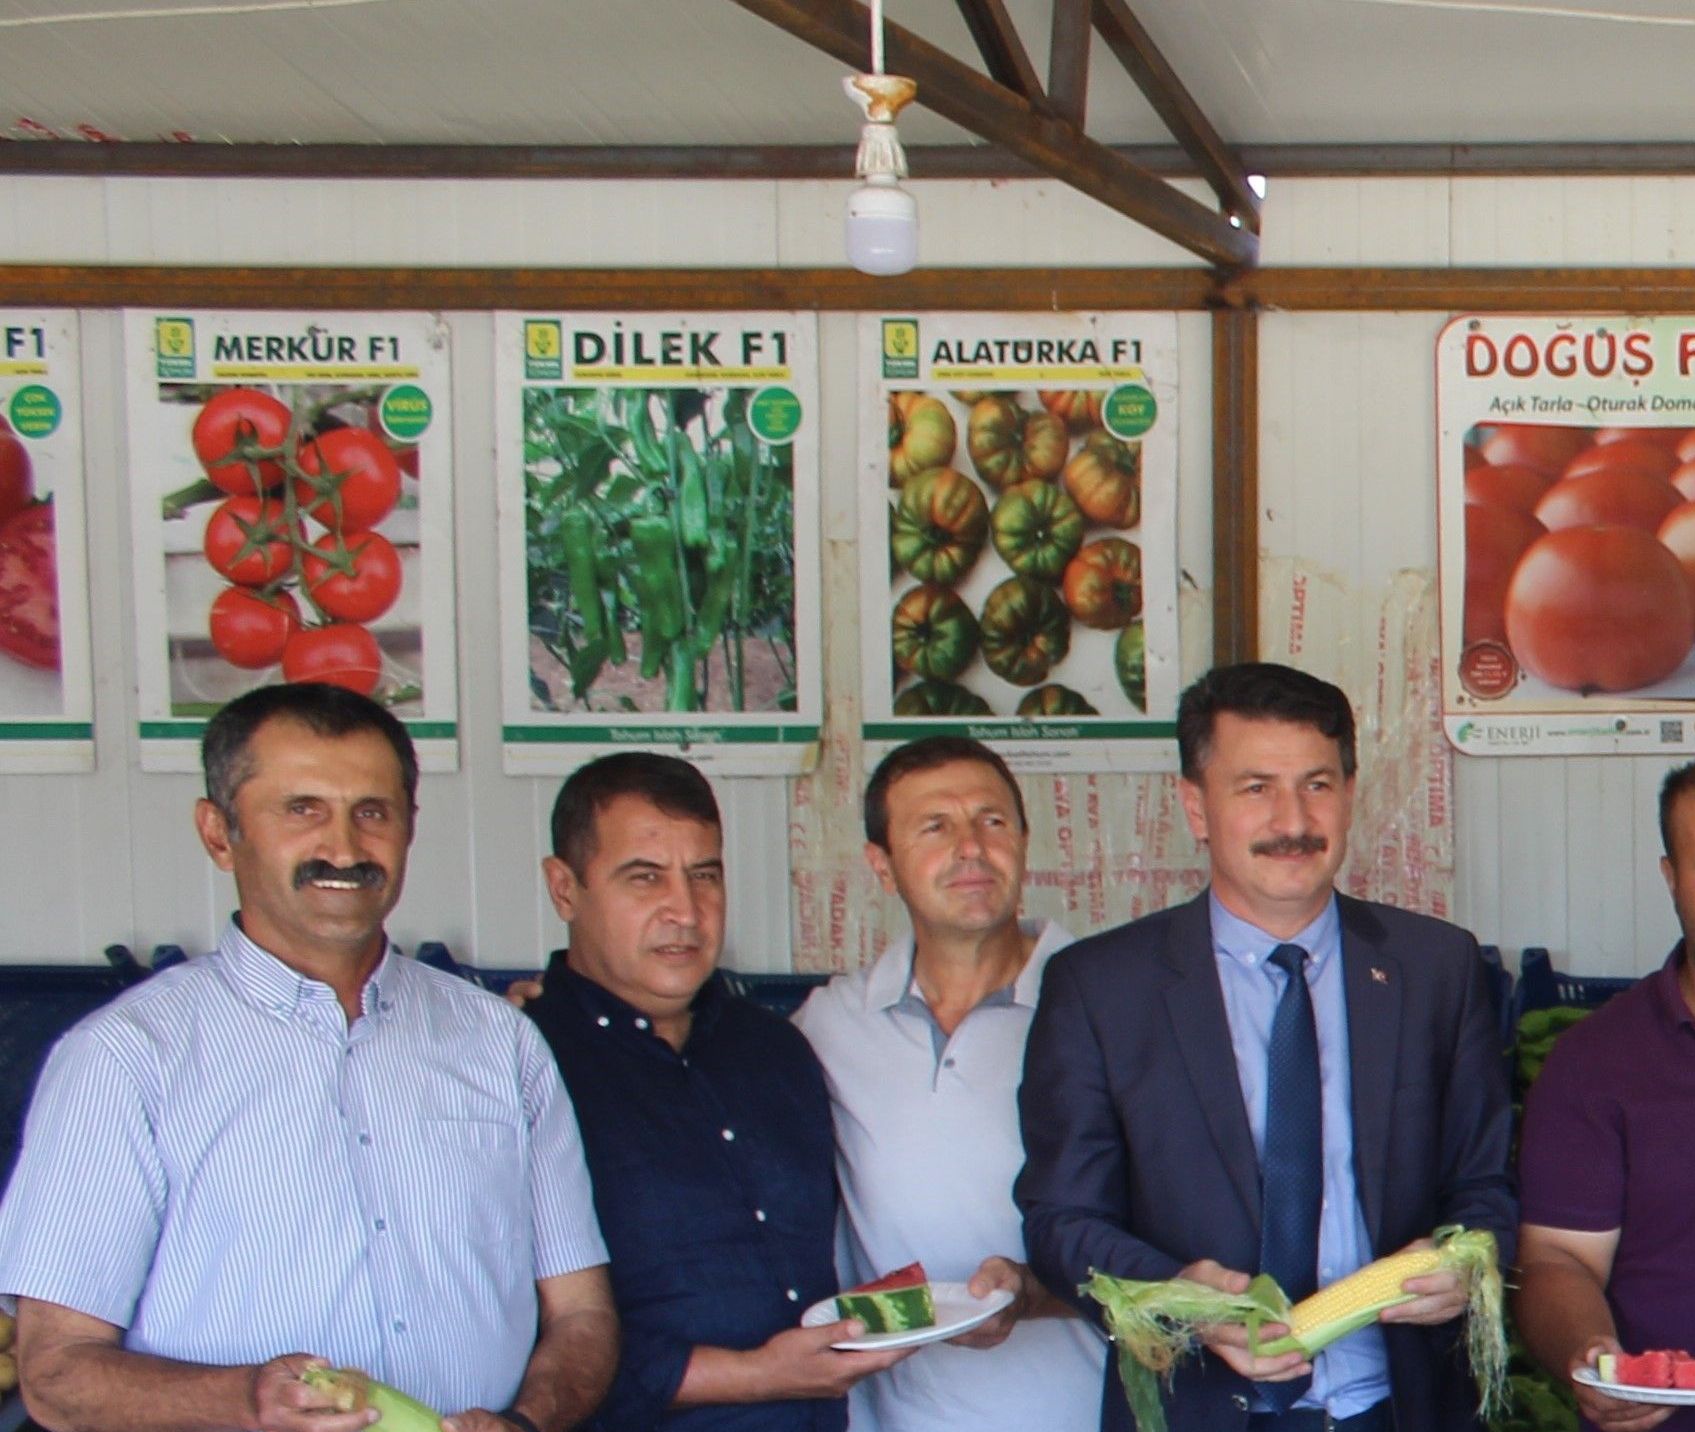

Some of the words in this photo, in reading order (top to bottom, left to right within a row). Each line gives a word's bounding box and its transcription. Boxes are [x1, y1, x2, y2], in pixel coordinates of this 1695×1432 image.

[6, 326, 44, 358] F1
[369, 337, 400, 361] F1
[574, 321, 722, 366] DİLEK
[742, 332, 787, 366] F1
[1112, 340, 1142, 364] F1
[1466, 322, 1655, 387] DOĞUŞ
[1489, 396, 1525, 415] Açık
[1531, 396, 1573, 412] Tarla
[1587, 396, 1647, 412] Oturak
